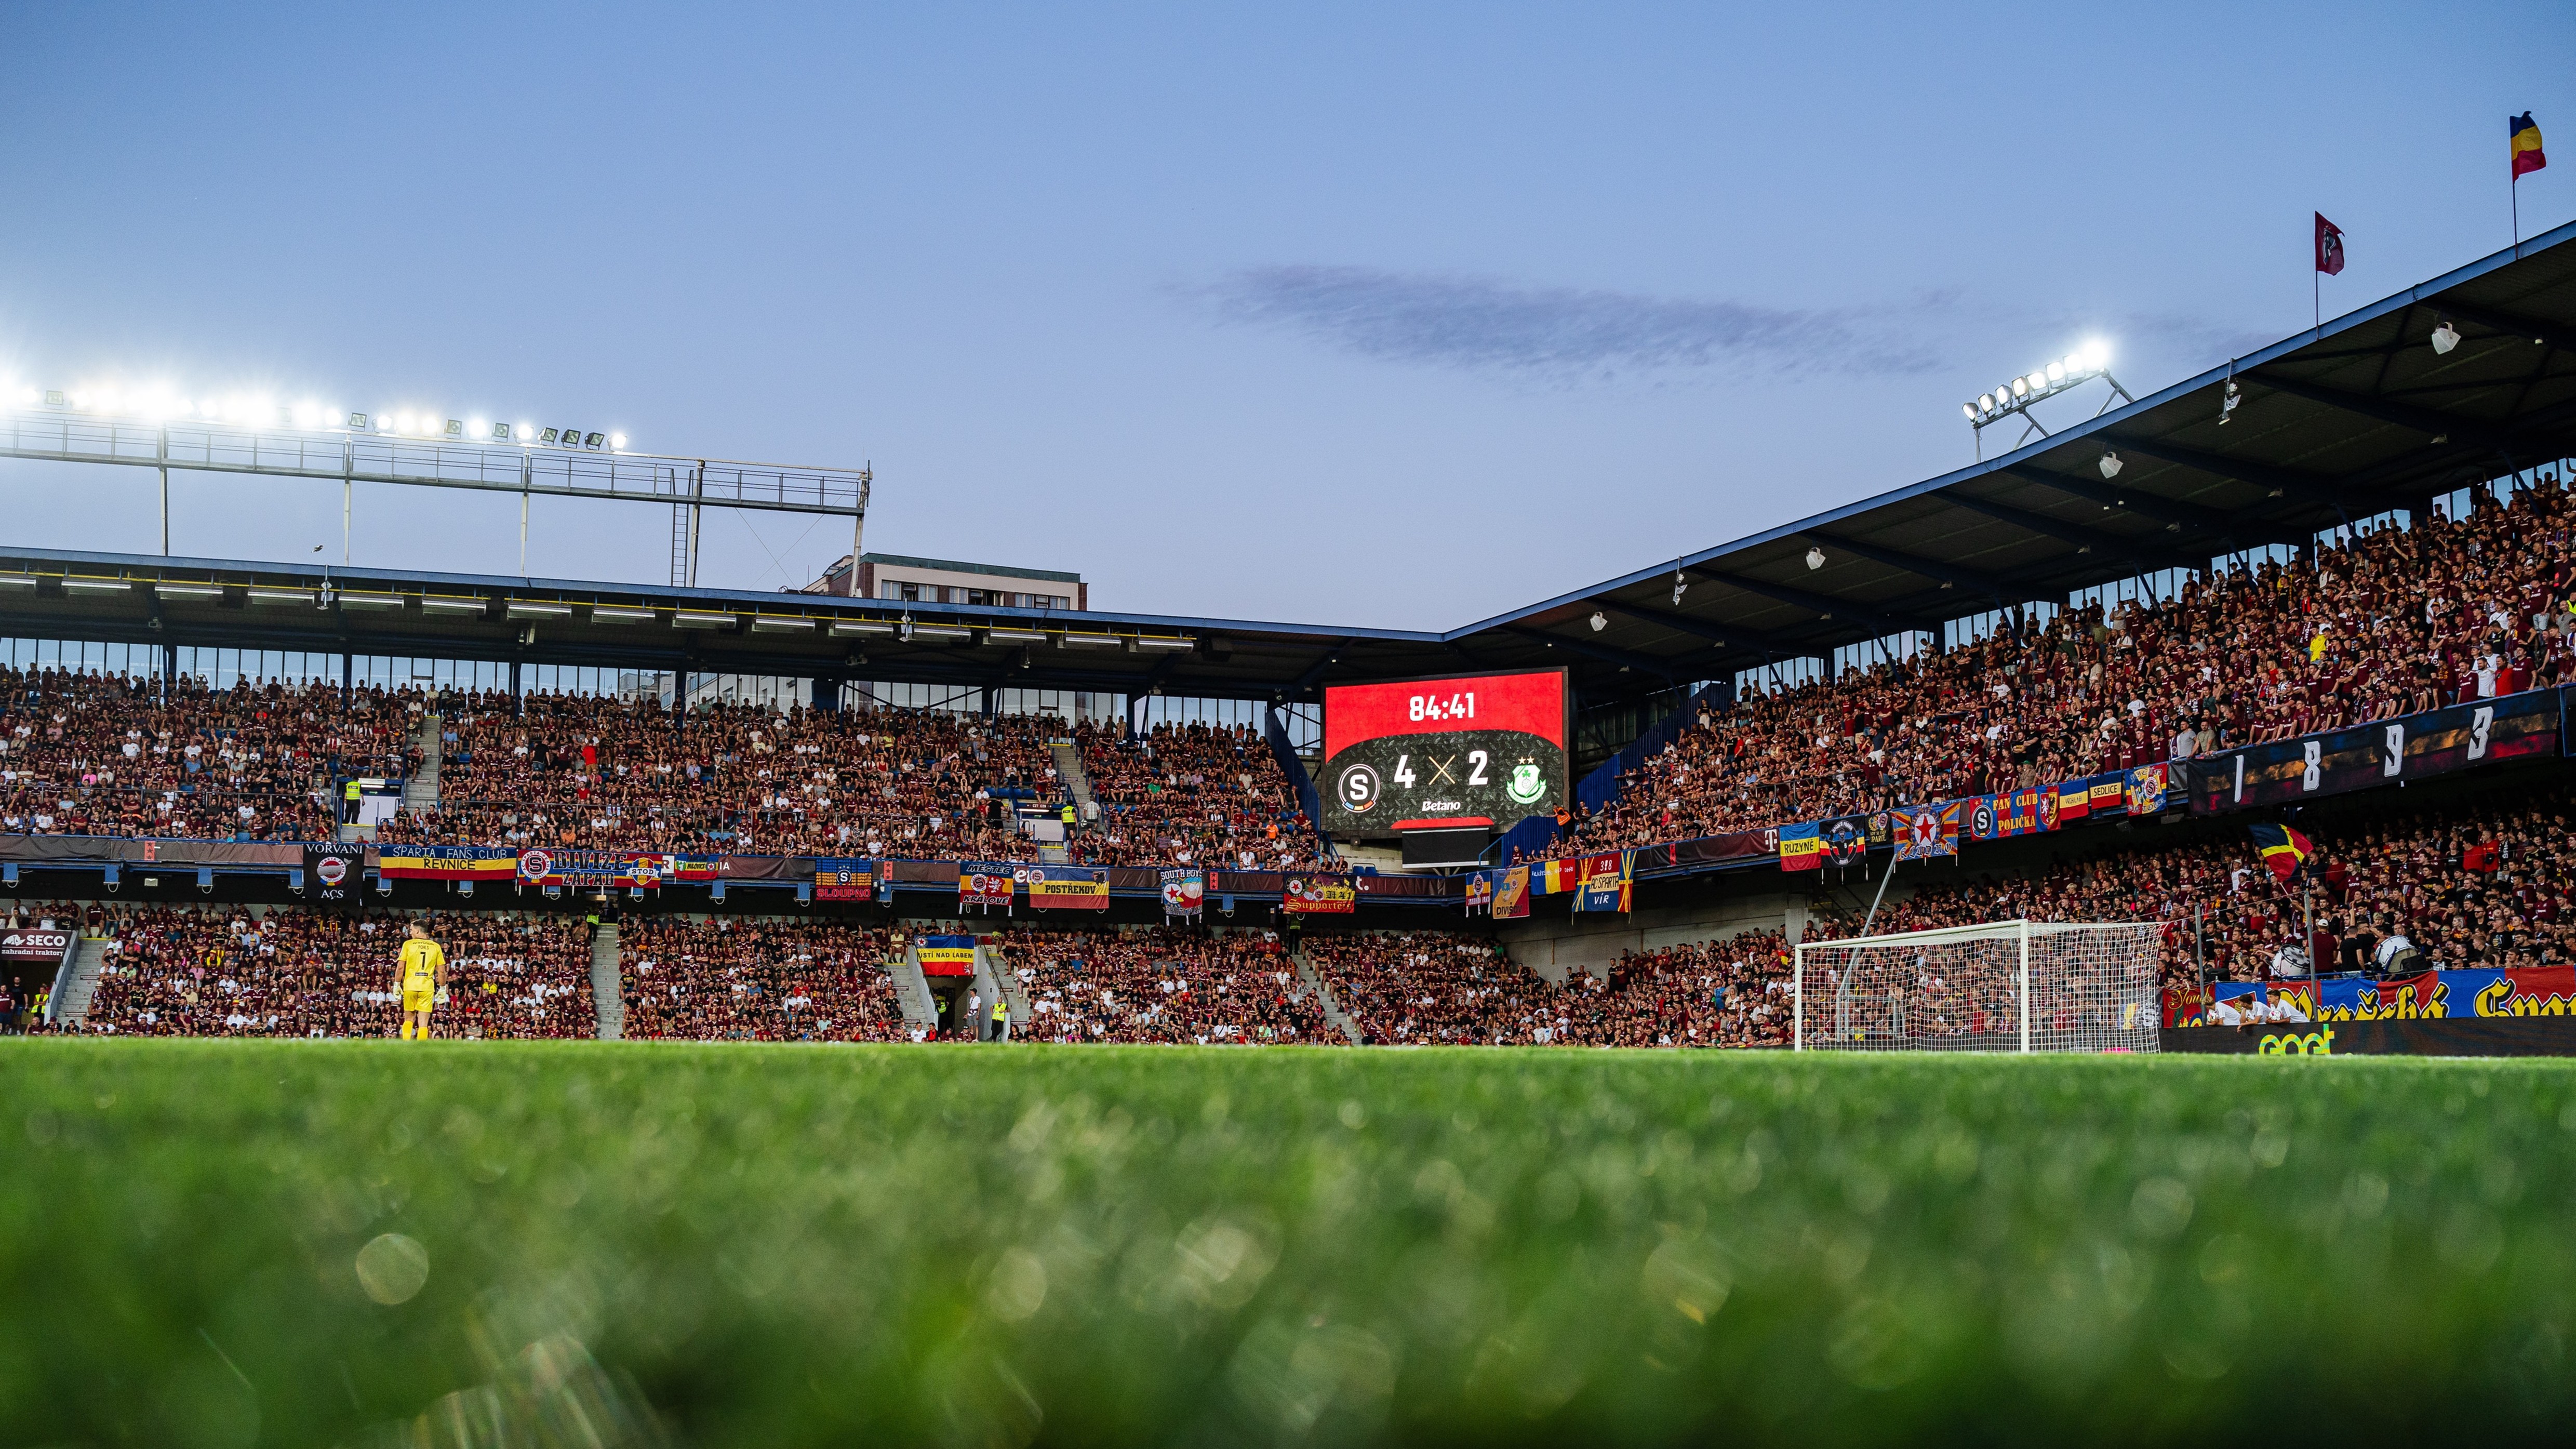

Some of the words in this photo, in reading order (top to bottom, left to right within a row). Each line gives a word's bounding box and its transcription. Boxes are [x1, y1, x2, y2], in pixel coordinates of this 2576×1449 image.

[1409, 693, 1474, 721] 84:41
[1394, 755, 1416, 789] 4
[1469, 750, 1488, 785] 2
[1350, 774, 1368, 800] S
[2094, 785, 2117, 796] SEDLICE
[1422, 801, 1461, 812] Betano
[1993, 797, 2011, 810] FAN
[2016, 793, 2038, 807] CLUB
[1978, 812, 1987, 829] S
[1998, 815, 2036, 831] POLIČKA
[306, 844, 363, 854] VORVANI
[1784, 839, 1813, 854] RUZYNĚ
[393, 847, 436, 858] SPARTA
[447, 848, 473, 859] FANS
[478, 849, 507, 859] CLUB
[319, 857, 336, 867] SPARTA
[423, 855, 476, 870] ŘEVNICE
[522, 852, 540, 862] SPARTA
[542, 854, 551, 871] PRAHA
[552, 850, 628, 871] DIVIZE
[967, 863, 1011, 874] MĚSTEC
[1160, 869, 1185, 880] SOUTH
[563, 869, 615, 886] ZÁPAD
[1591, 878, 1598, 889] AC
[1598, 875, 1619, 888] SPARTA
[817, 888, 871, 897] SLOUPNO
[1045, 882, 1096, 894] POSTŘEKOV
[963, 894, 1010, 905] KRÁLOVÉ
[1286, 898, 1351, 910] Supporters
[1594, 893, 1609, 905] VÍR
[1497, 902, 1523, 915] DIVIŠOV
[26, 935, 65, 946] SECO
